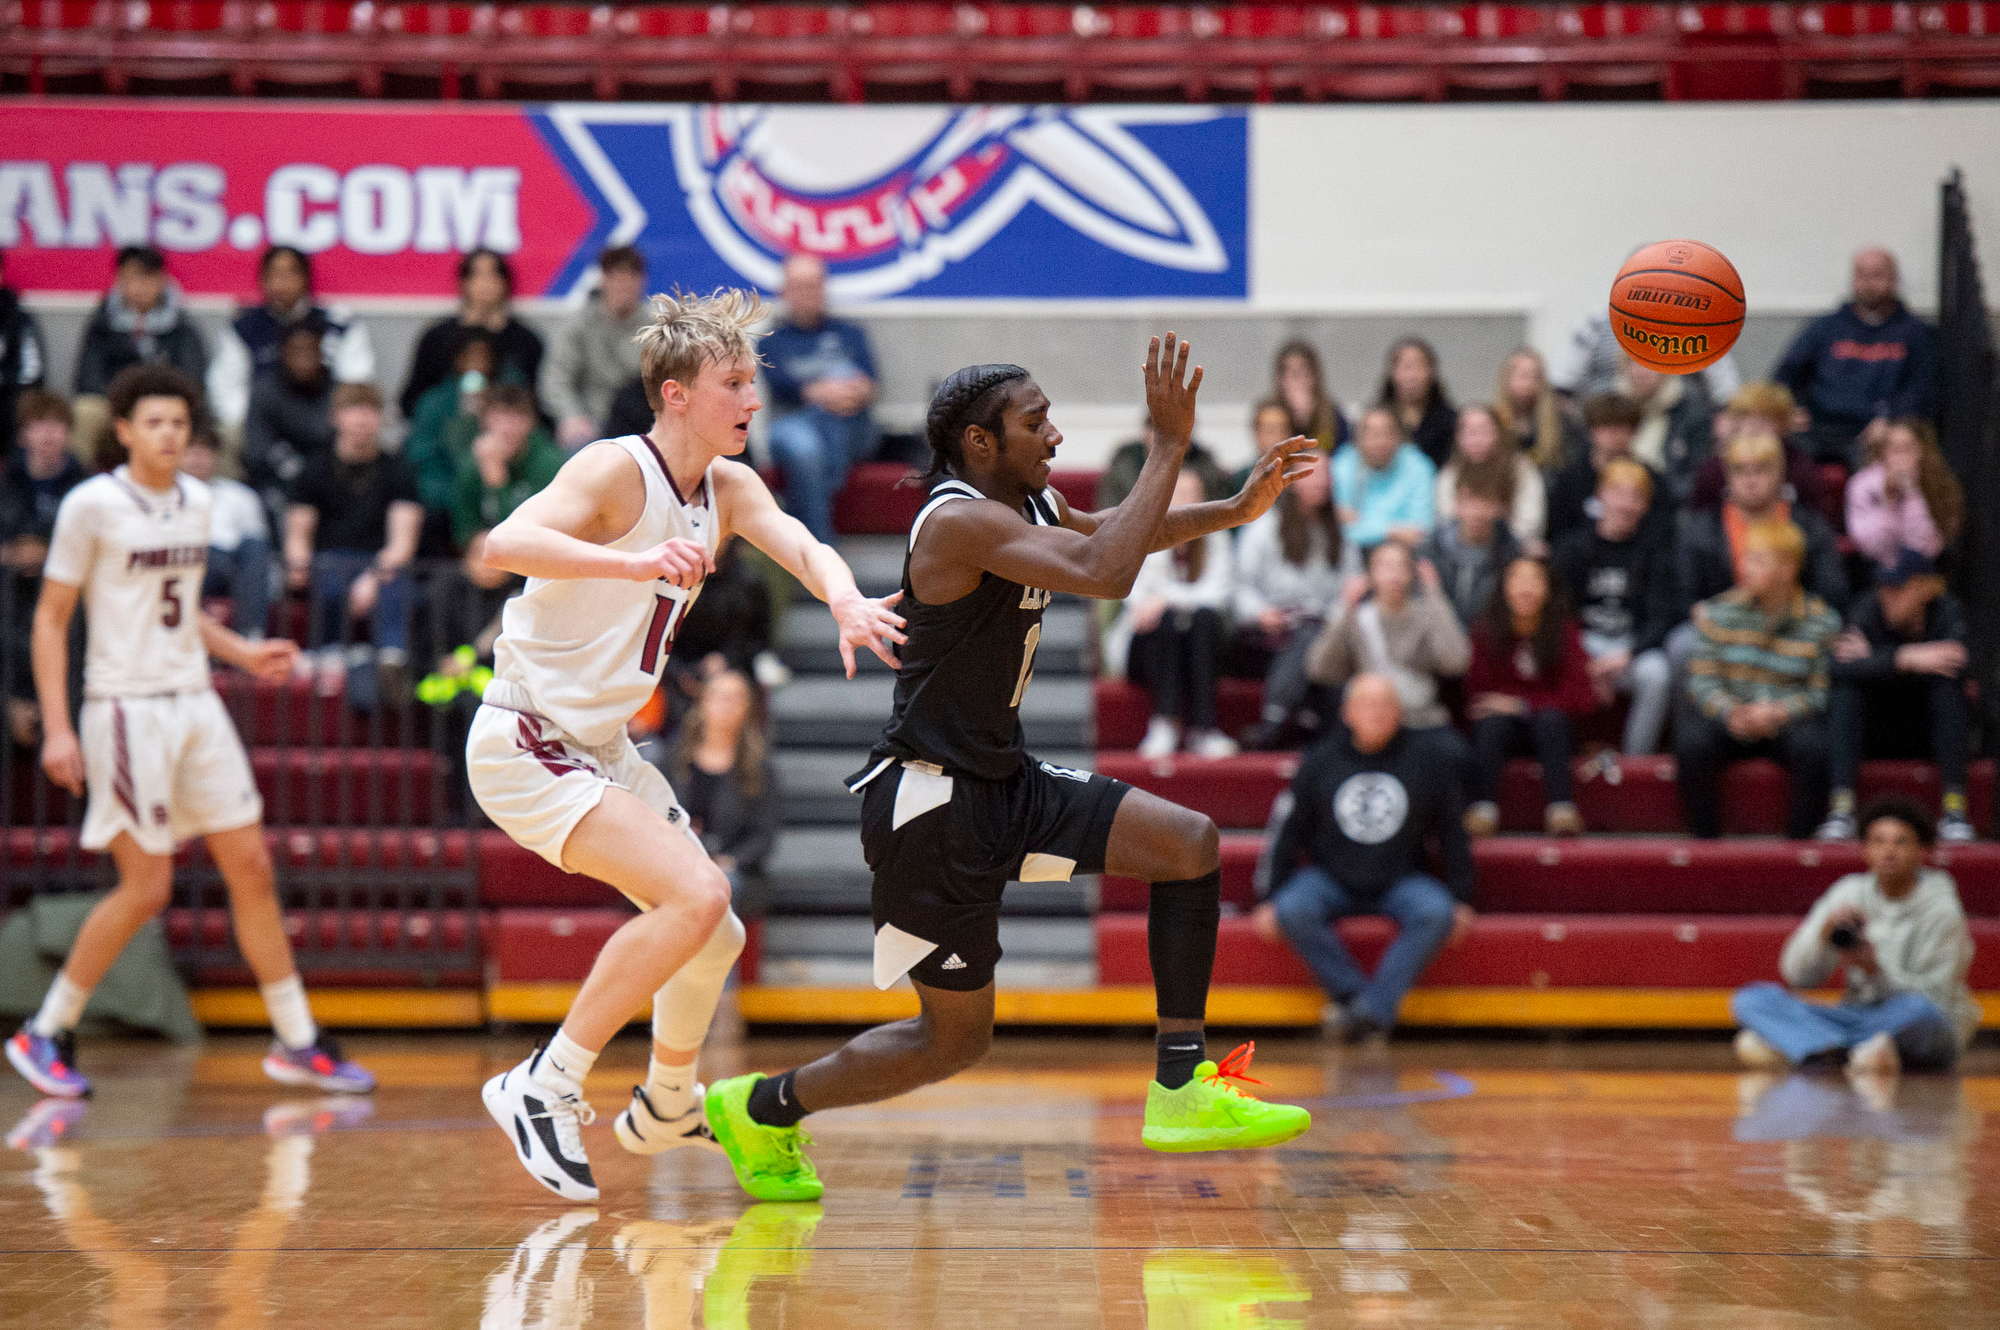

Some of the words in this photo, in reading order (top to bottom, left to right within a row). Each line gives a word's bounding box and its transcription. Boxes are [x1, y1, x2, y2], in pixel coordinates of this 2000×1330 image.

[1626, 289, 1712, 312] EVOLUTION
[1622, 321, 1710, 355] Wilson
[162, 578, 182, 628] 5
